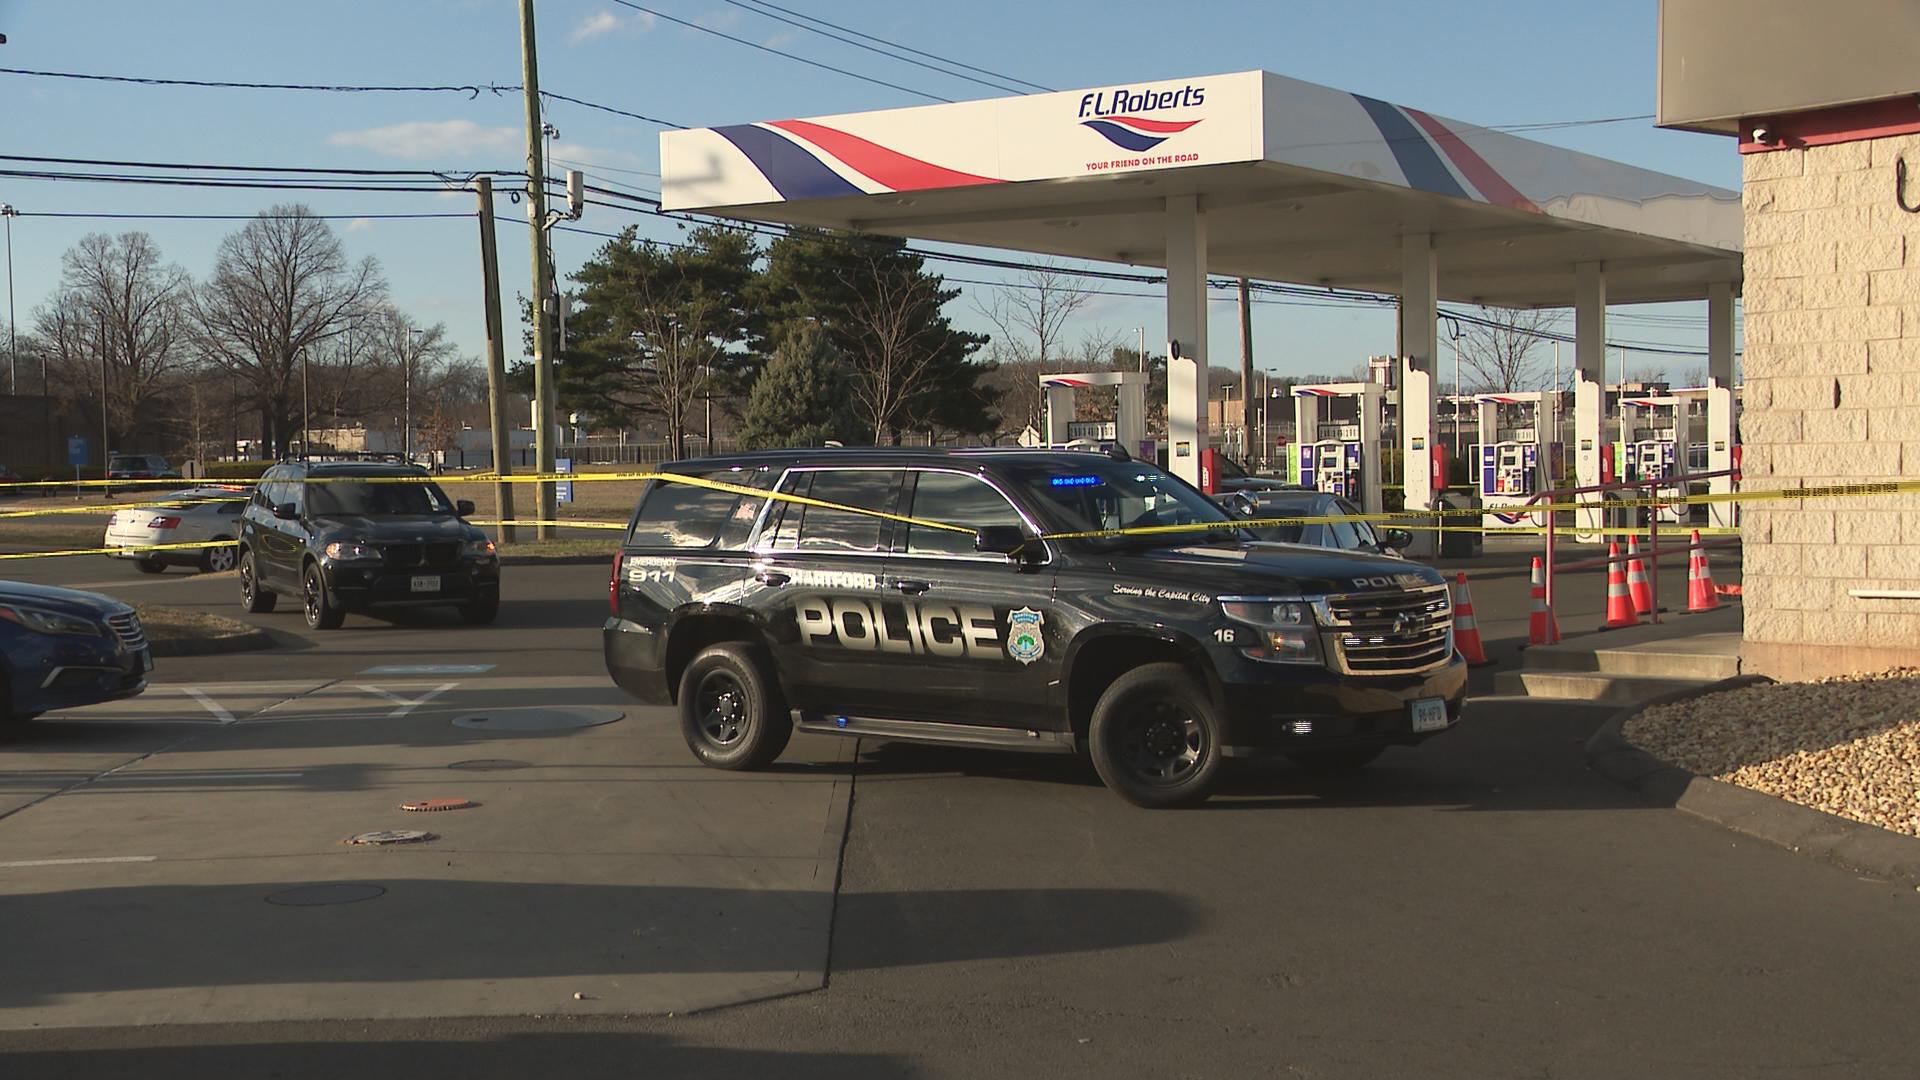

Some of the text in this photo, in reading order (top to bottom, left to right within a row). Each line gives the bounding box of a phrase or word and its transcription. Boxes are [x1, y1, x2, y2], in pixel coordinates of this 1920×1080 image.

[1086, 153, 1199, 171] YOUR FRIEND ON THE ROAD
[629, 570, 675, 583] 911
[790, 569, 877, 590] HARTFORD
[1352, 573, 1426, 589] POLICE
[1112, 583, 1211, 604] Serving the Capital City
[796, 599, 1005, 659] POLICE
[1213, 628, 1235, 643] 16
